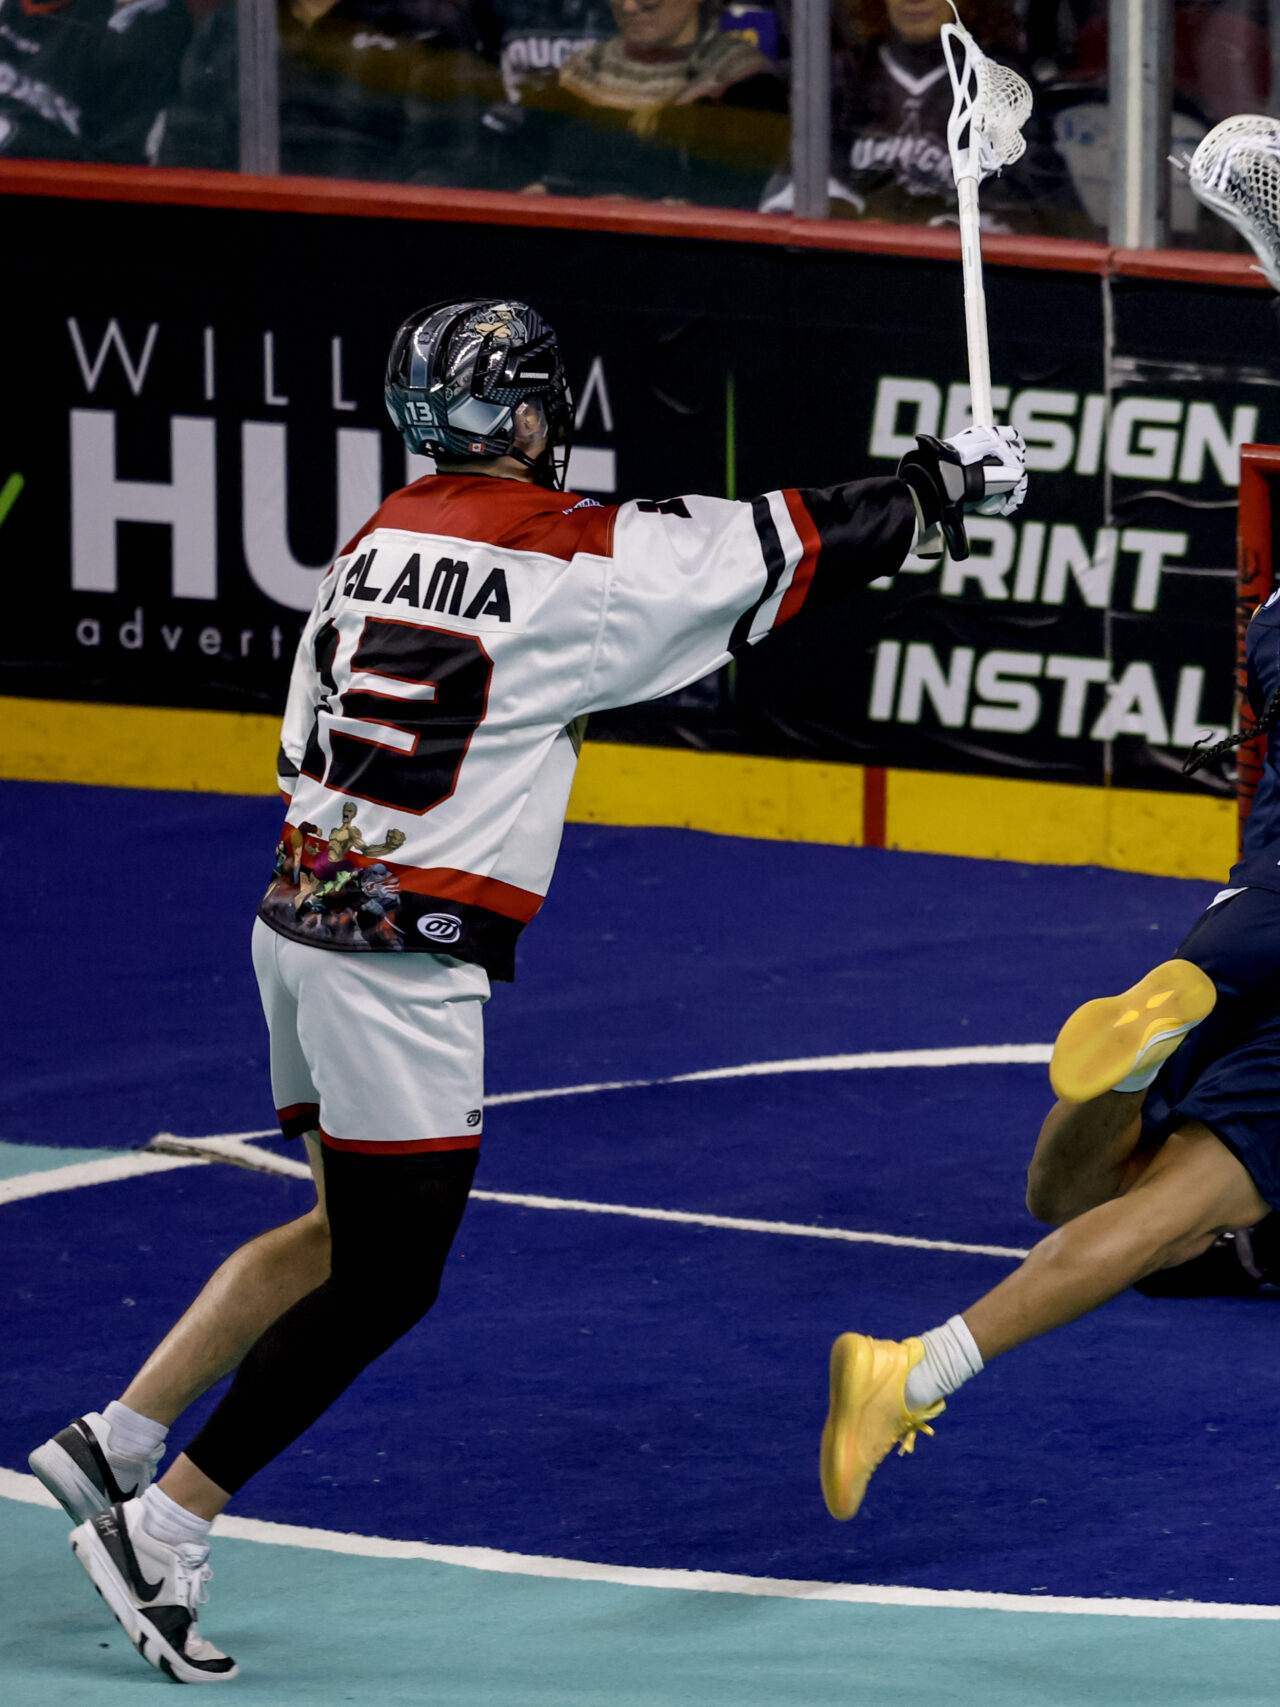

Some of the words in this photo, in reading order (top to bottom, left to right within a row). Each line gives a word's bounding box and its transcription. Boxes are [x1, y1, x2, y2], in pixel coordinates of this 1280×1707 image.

[406, 401, 433, 421] 13
[322, 548, 511, 623] ALAMA
[868, 640, 1240, 750] INSTAL
